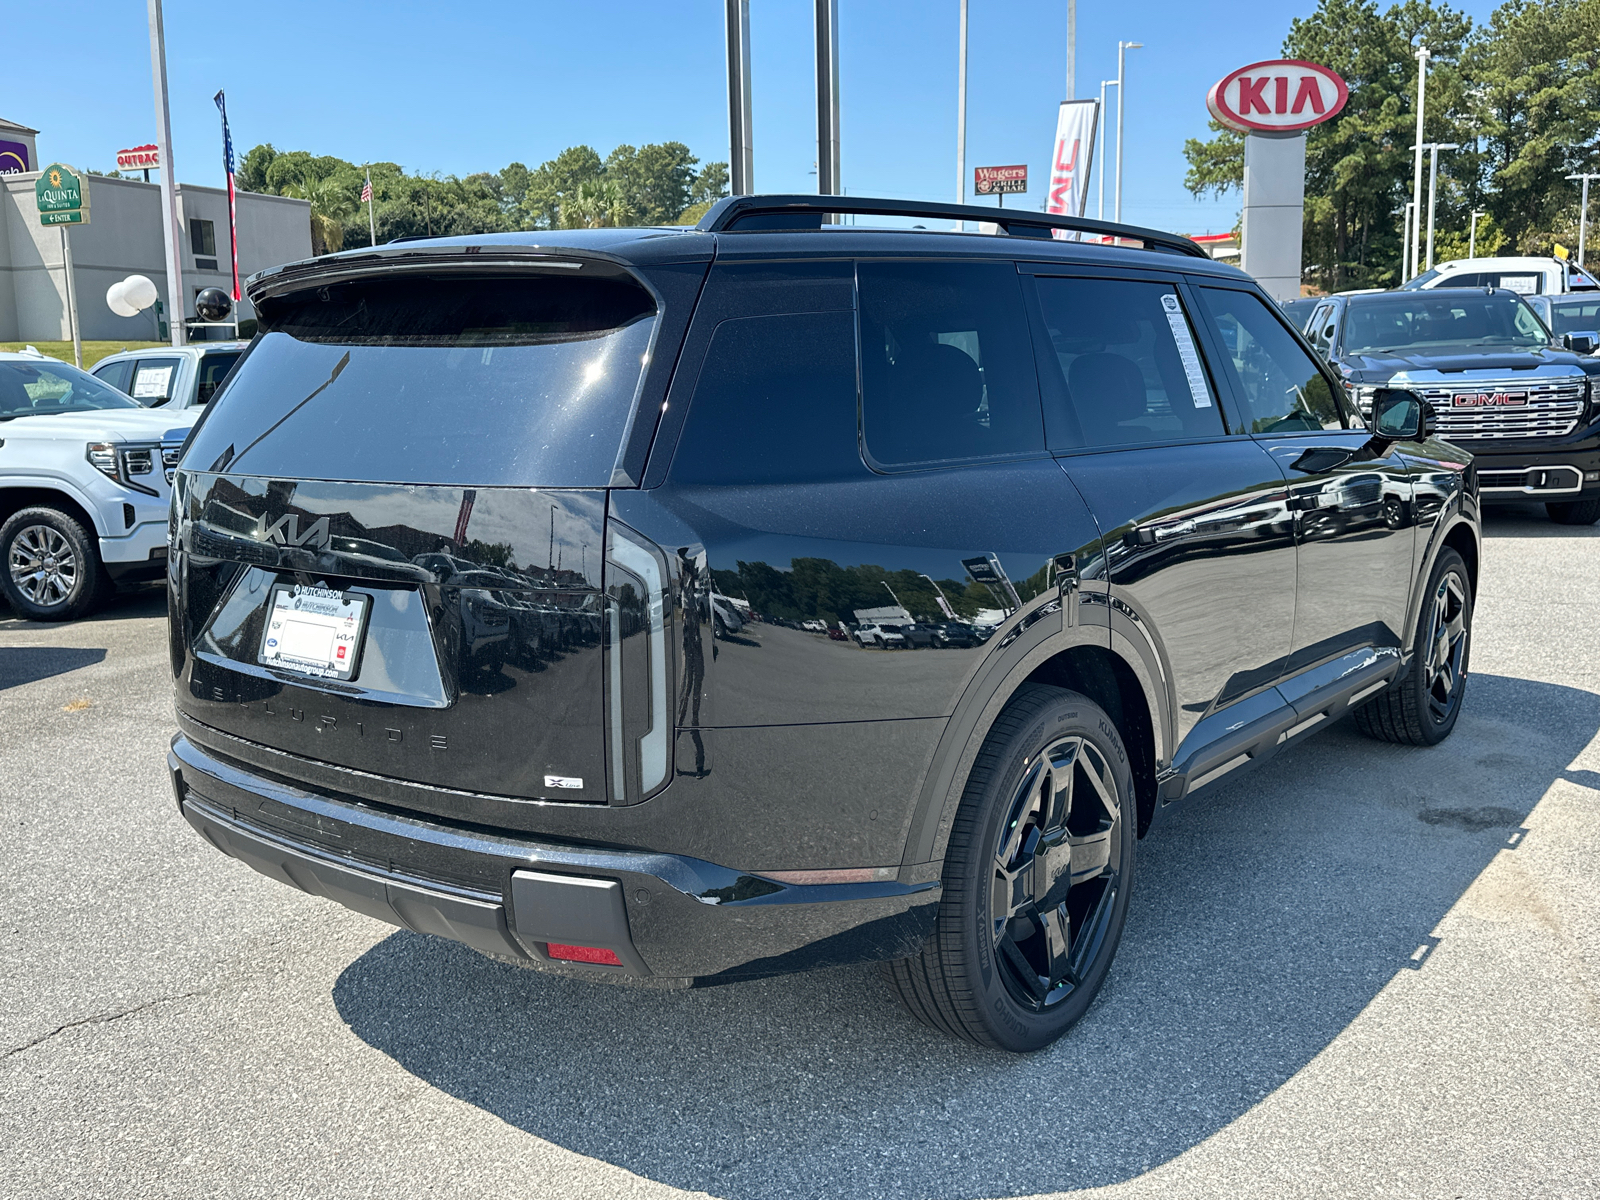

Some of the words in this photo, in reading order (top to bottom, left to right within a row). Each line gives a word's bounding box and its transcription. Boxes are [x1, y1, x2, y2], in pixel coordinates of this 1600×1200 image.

[1238, 76, 1325, 114] KIA
[117, 152, 159, 166] OUTBAC
[977, 168, 1025, 180] Wagers
[44, 189, 79, 204] QUINTA
[1049, 139, 1080, 237] MC
[55, 214, 71, 222] ENTER
[1455, 392, 1525, 406] GMC
[257, 511, 329, 549] KIA
[301, 587, 343, 600] HUTCHINSON
[193, 678, 449, 750] TELLURIDE
[1057, 712, 1079, 723] OUTSIDE
[1098, 718, 1125, 764] KUMHO
[979, 923, 989, 970] Majesty
[994, 997, 1030, 1038] KUMHO
